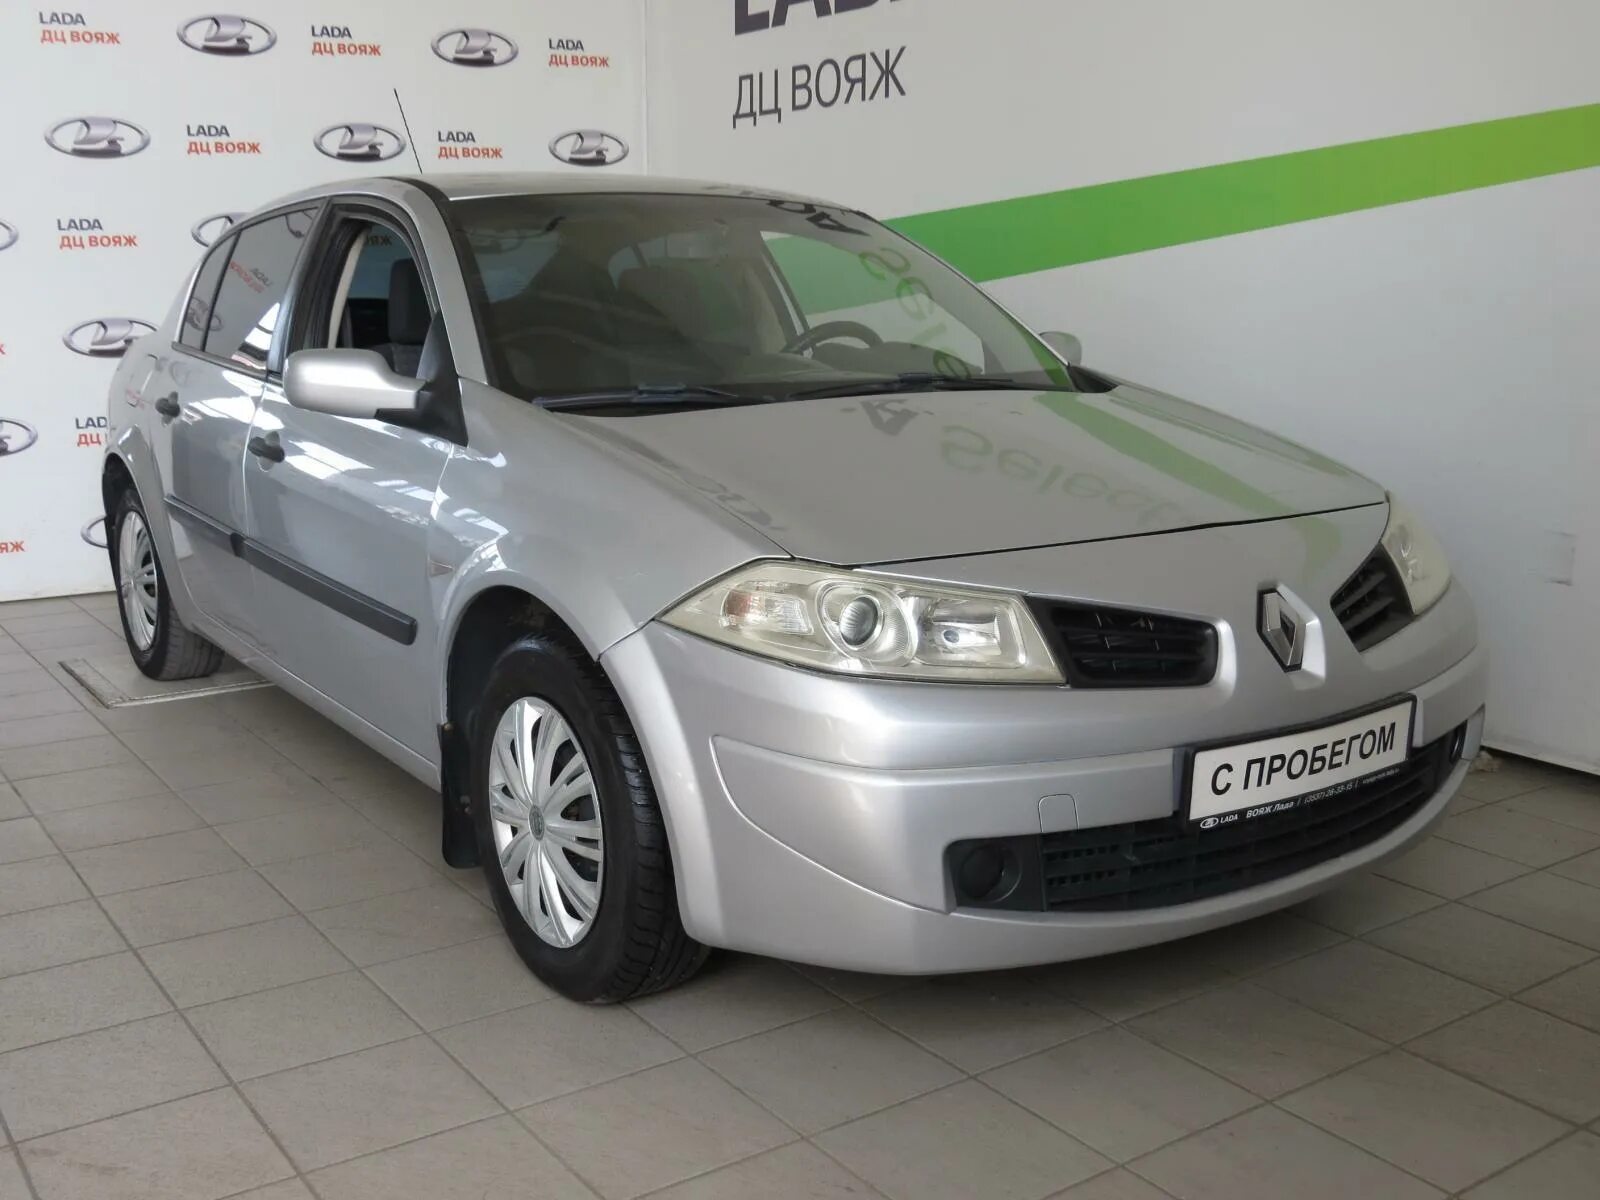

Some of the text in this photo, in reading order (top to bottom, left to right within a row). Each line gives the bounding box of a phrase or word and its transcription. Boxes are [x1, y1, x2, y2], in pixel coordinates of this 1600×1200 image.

[39, 12, 86, 26] LADA
[41, 30, 120, 44] ДЦ ВОЯЖ
[312, 25, 352, 39] LADA
[312, 42, 381, 56] ДЦ ВОЯЖ
[549, 38, 584, 51] LADA
[549, 54, 609, 68] ДЦ ВОЯЖ
[733, 46, 906, 129] ДЦ ВОЯЖ
[187, 125, 229, 137] LADA
[438, 131, 475, 143] LADA
[187, 142, 260, 155] ДЦ ВОЯЖ
[438, 147, 502, 159] ДЦ ВОЯЖ
[57, 219, 103, 231] LADA
[60, 235, 137, 249] ДЦ ВОЯЖ
[76, 417, 107, 429] LAD
[77, 434, 101, 447] ДЦ
[0, 541, 25, 553] ЯЖ
[1211, 722, 1396, 796] С ПРОБЕГОМ
[1246, 805, 1273, 818] ВОЯЖ
[1273, 801, 1294, 813] Лада
[1220, 814, 1238, 824] LADA
